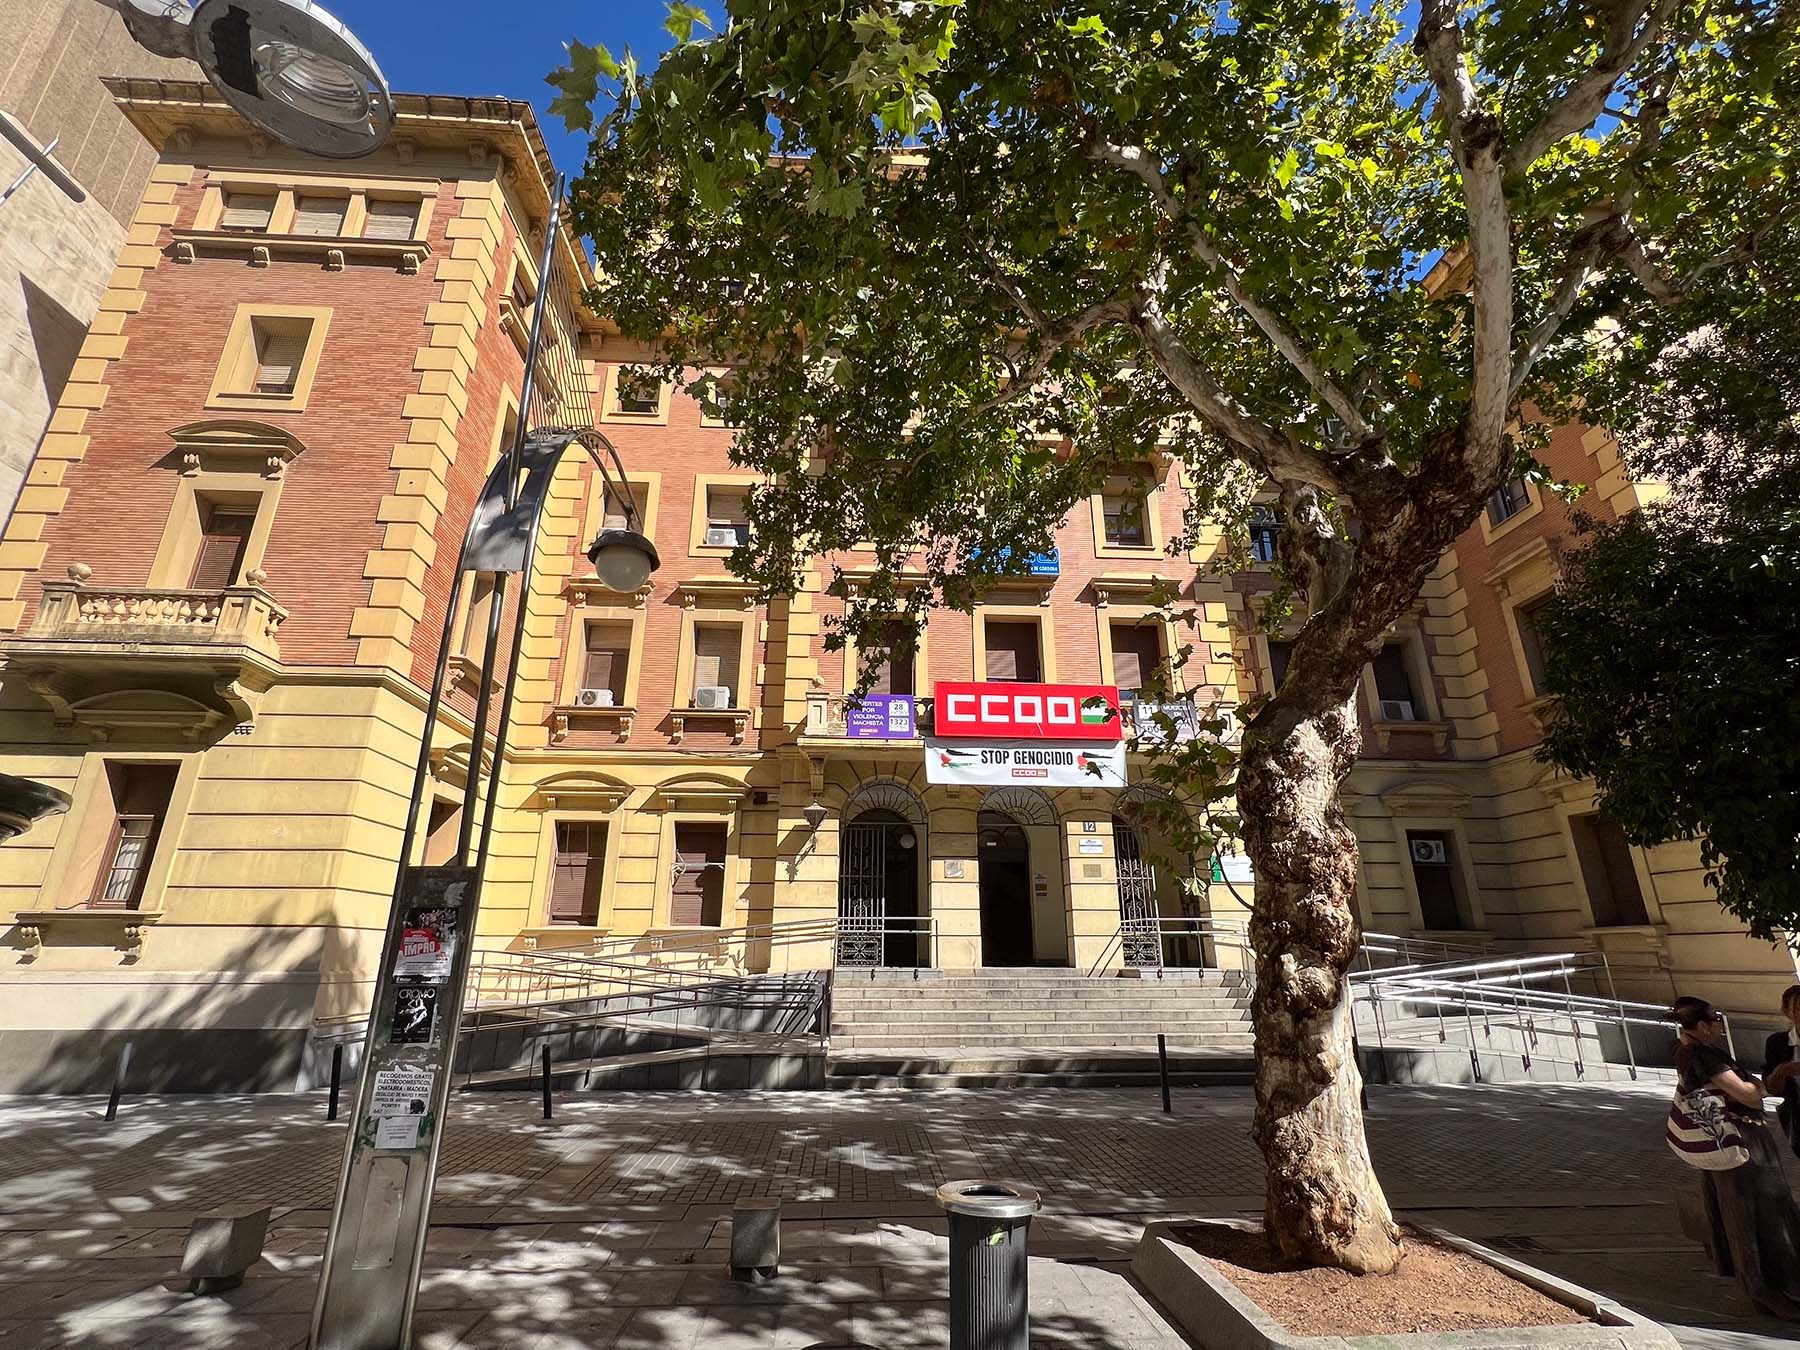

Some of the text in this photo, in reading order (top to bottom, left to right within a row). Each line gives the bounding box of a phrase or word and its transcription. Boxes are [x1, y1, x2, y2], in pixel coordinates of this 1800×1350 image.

[860, 700, 883, 708] UERTES
[947, 694, 1076, 724] CCOO
[981, 750, 1074, 766] STOP GENOCIDIO
[1085, 822, 1095, 831] 12
[404, 941, 435, 956] IMPRO
[399, 988, 436, 1000] CROMO
